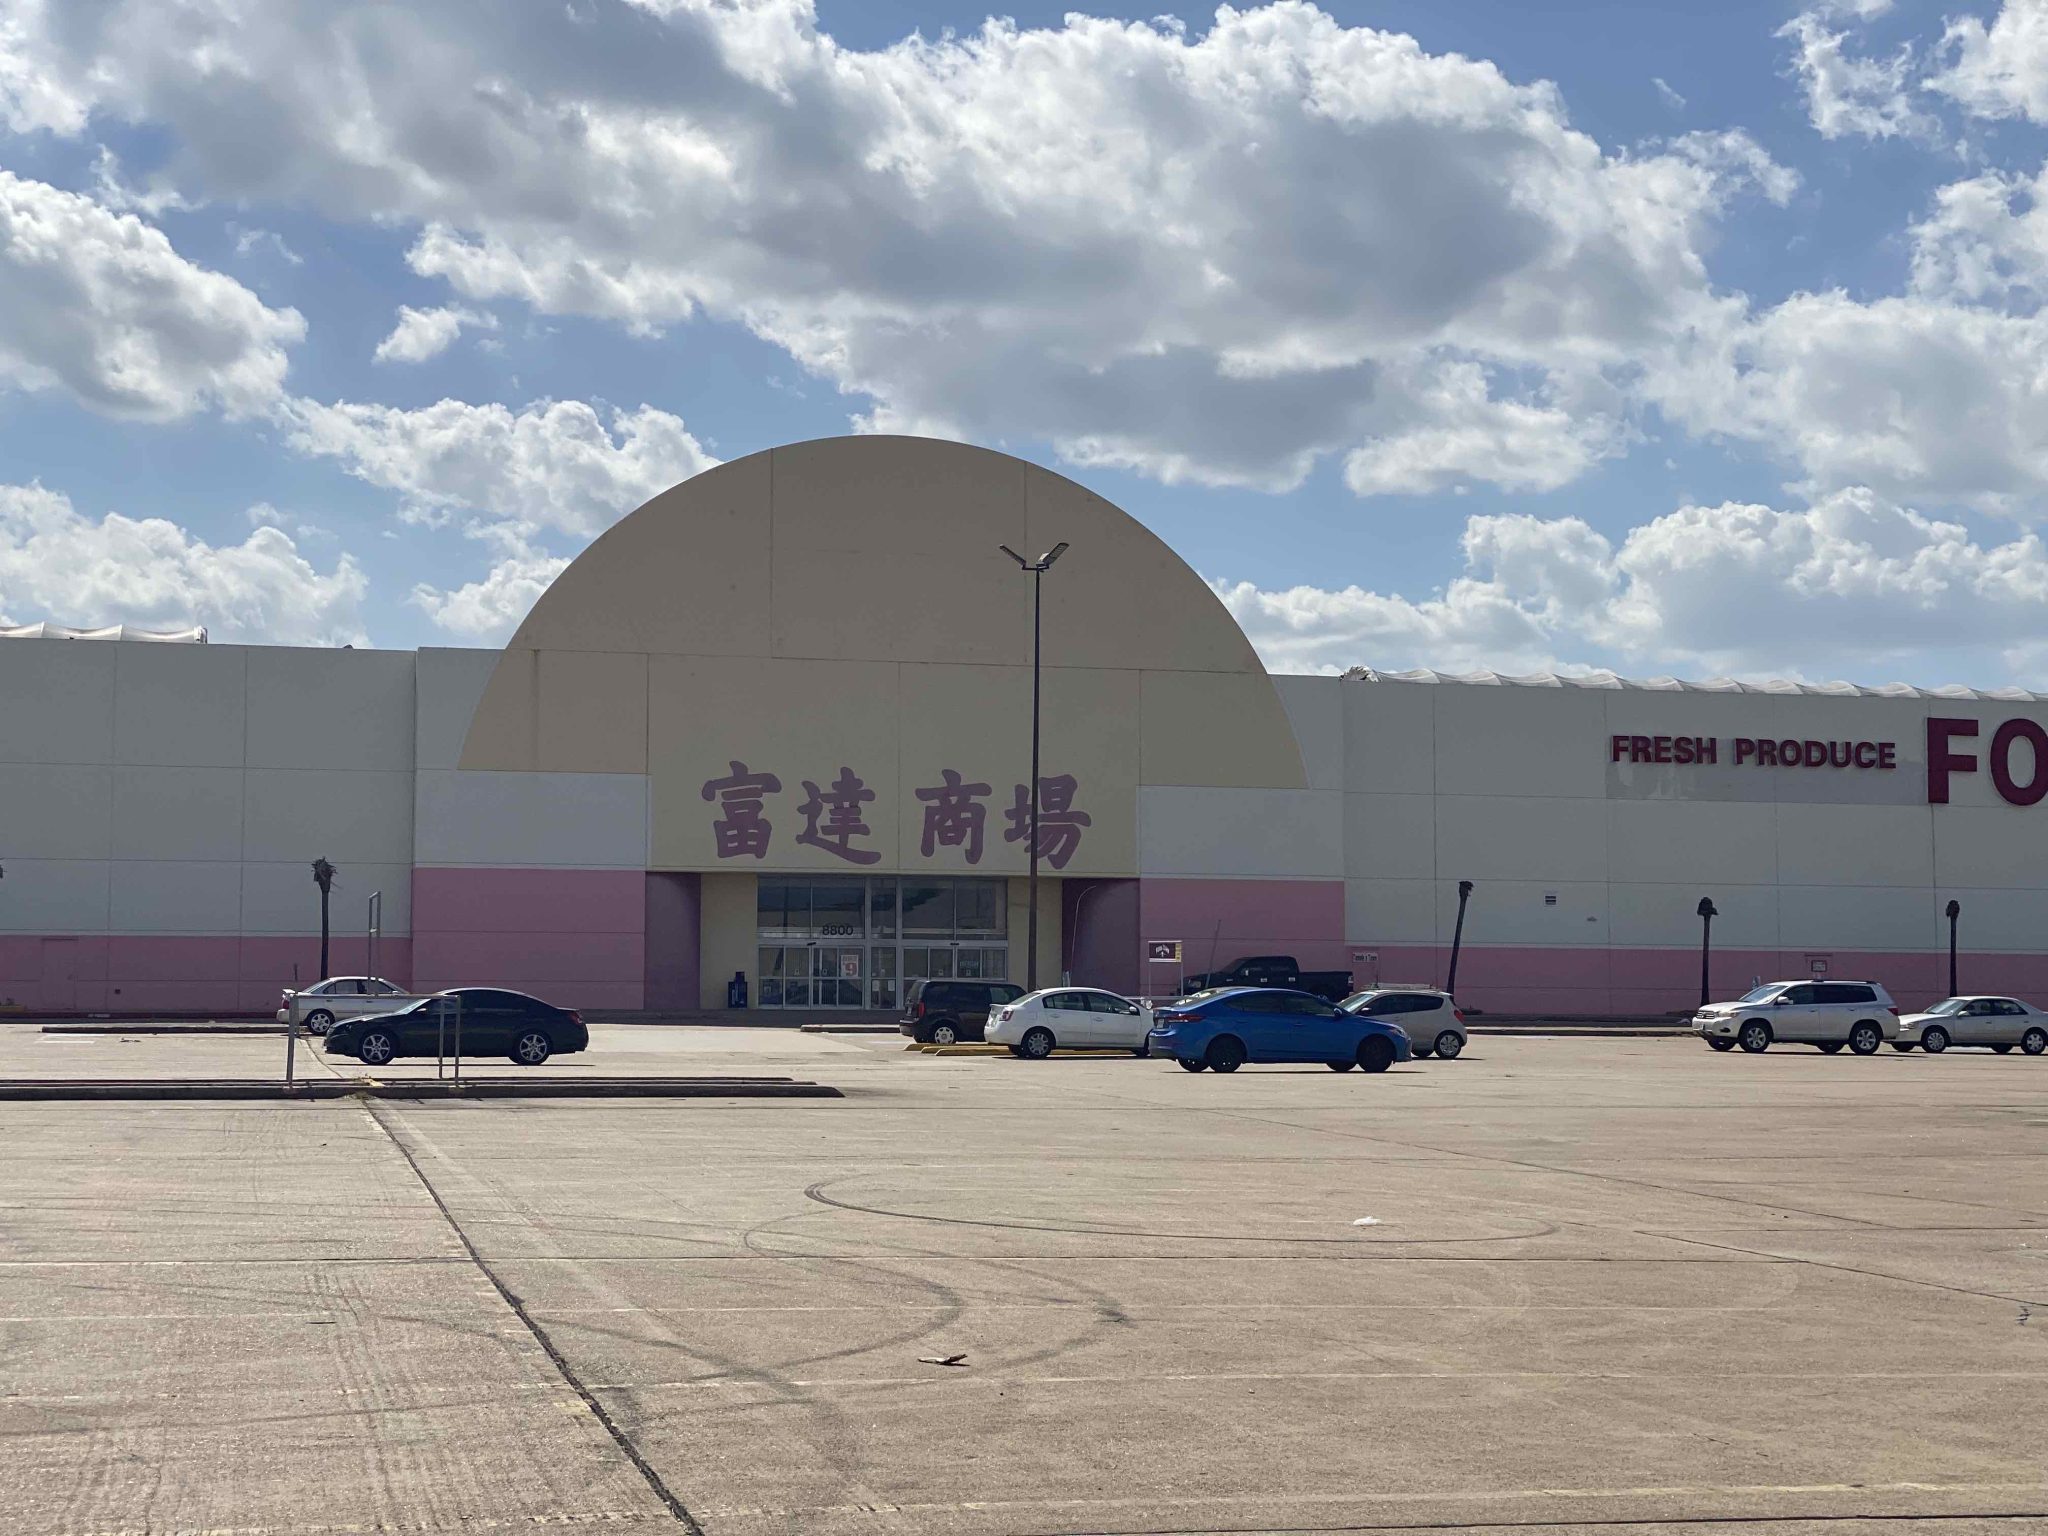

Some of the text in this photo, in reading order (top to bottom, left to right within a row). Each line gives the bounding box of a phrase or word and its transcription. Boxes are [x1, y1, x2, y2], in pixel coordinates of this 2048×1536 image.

[1611, 735, 1897, 769] FRESH PRODUCE
[701, 760, 1092, 870] 富達商場
[822, 924, 854, 937] 8800
